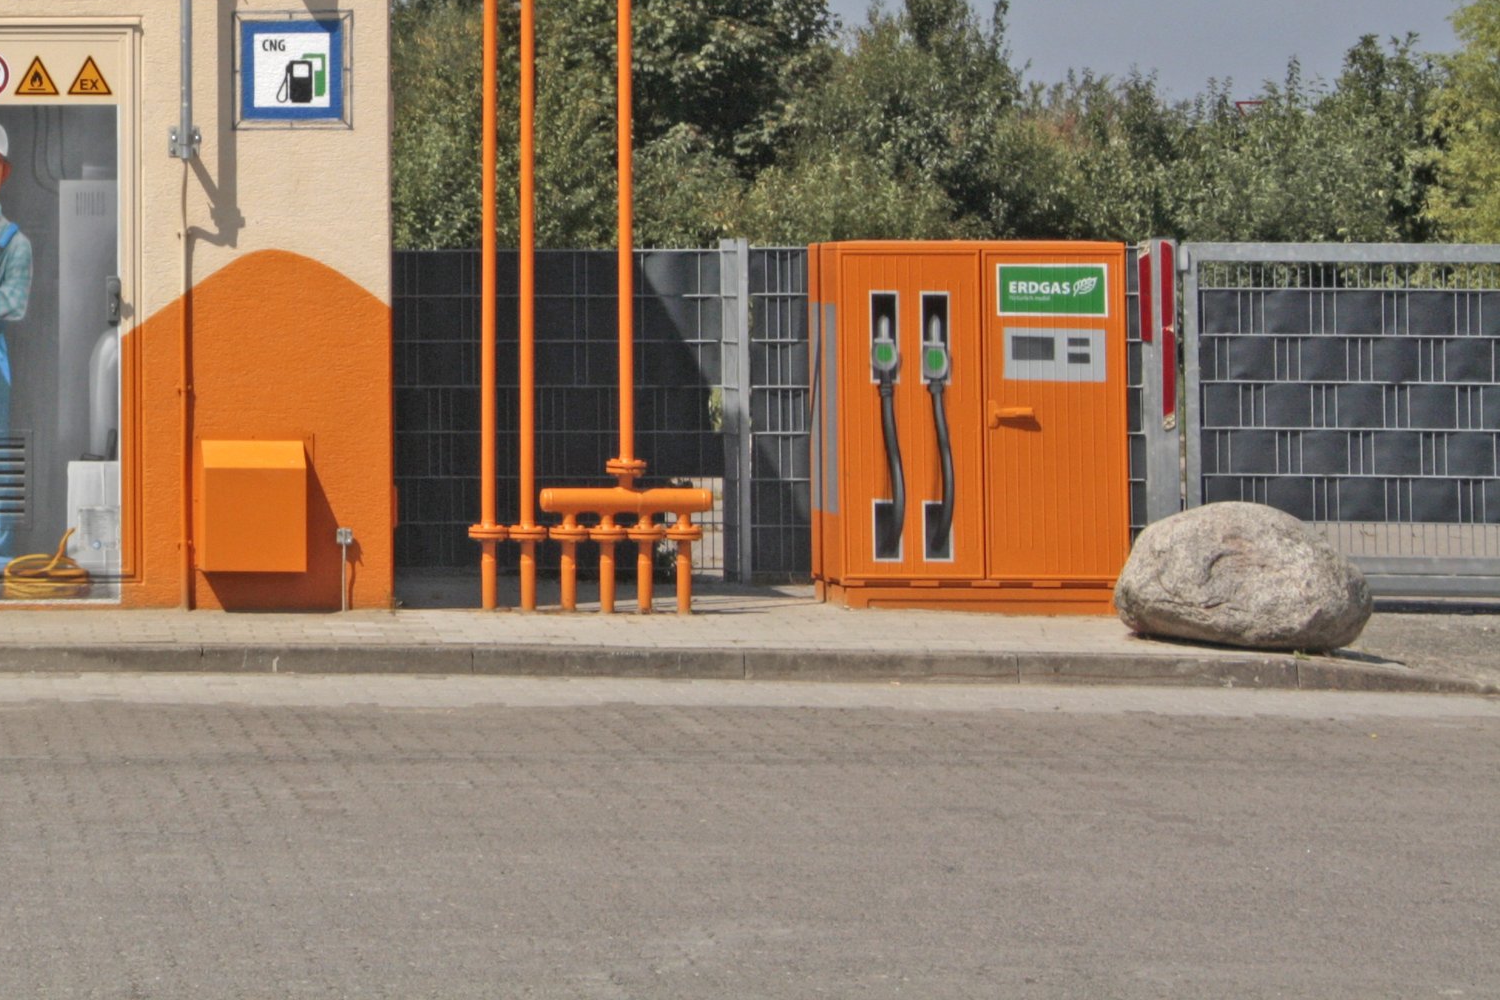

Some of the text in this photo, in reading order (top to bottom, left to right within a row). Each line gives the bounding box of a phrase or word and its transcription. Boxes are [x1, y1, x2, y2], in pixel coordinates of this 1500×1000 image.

[262, 39, 286, 51] CNG
[79, 79, 100, 91] EX
[1008, 281, 1071, 295] ERDGAS
